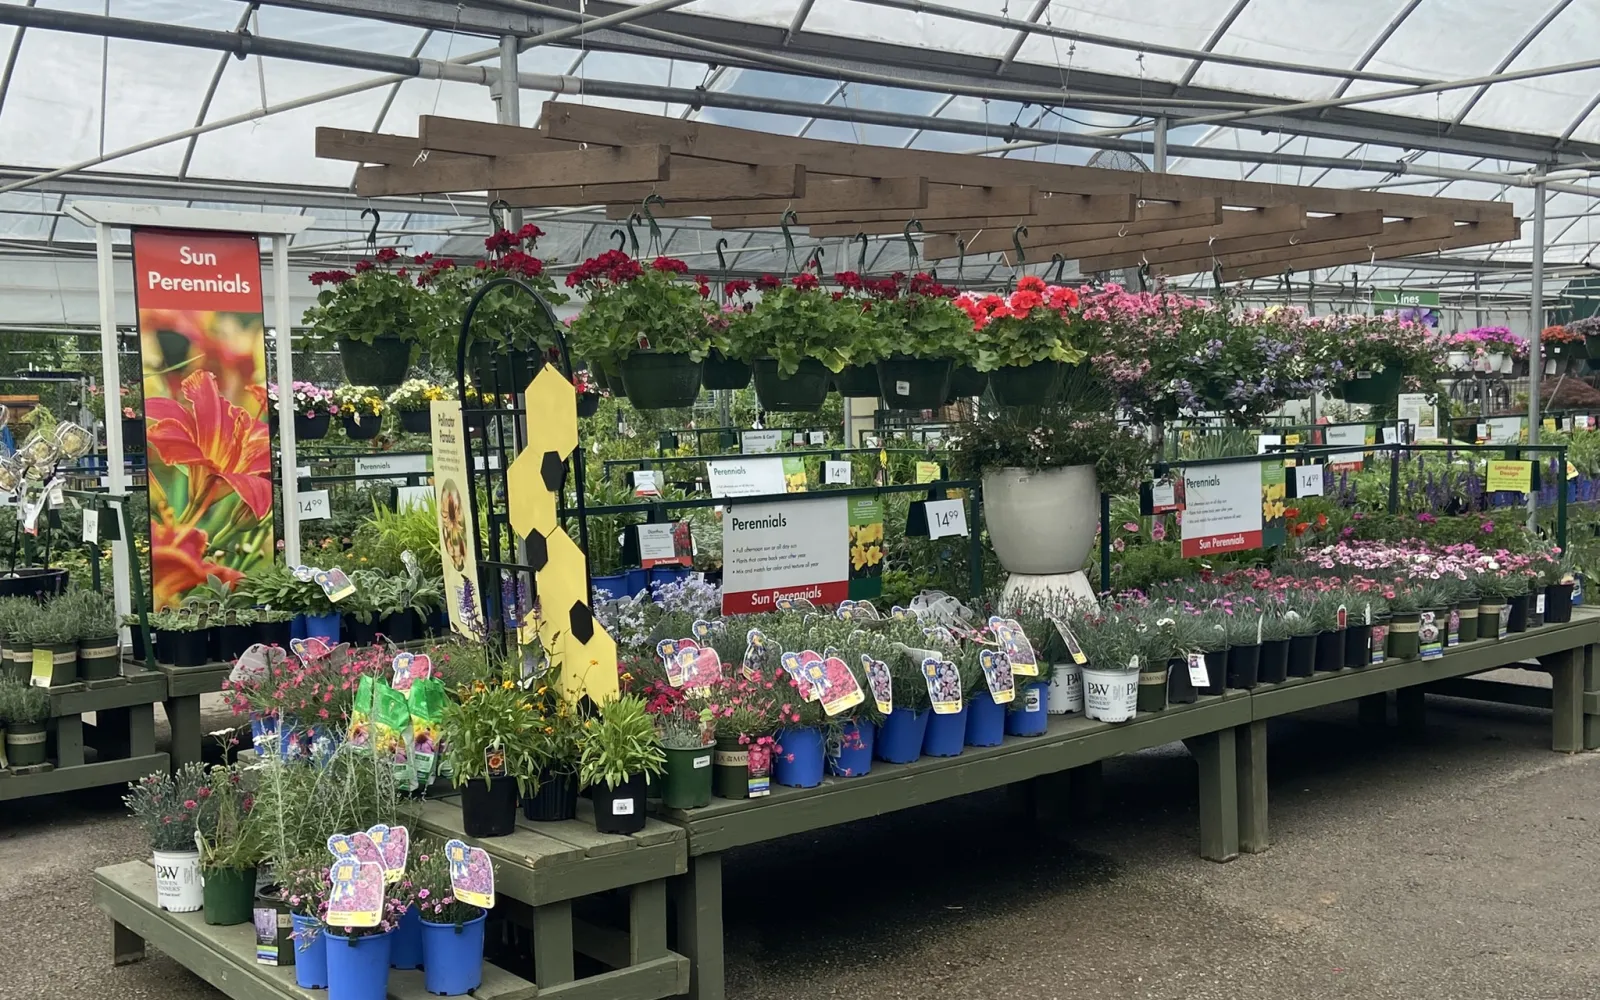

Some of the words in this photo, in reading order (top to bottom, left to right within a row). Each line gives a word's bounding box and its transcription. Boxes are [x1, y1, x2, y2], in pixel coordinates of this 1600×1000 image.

[180, 246, 217, 266] Sun
[148, 271, 251, 294] Perennials
[360, 462, 391, 470] Perennials
[713, 466, 747, 476] Perennials
[831, 467, 847, 478] 1499
[1186, 474, 1220, 489] Perennials
[1302, 473, 1319, 488] 1499
[298, 499, 322, 514] 1499
[732, 512, 787, 531] Perennials
[935, 510, 959, 528] 1499
[1199, 538, 1211, 549] Sun
[1212, 534, 1245, 547] Perennials
[751, 593, 770, 605] Sun
[773, 586, 822, 602] Perennials
